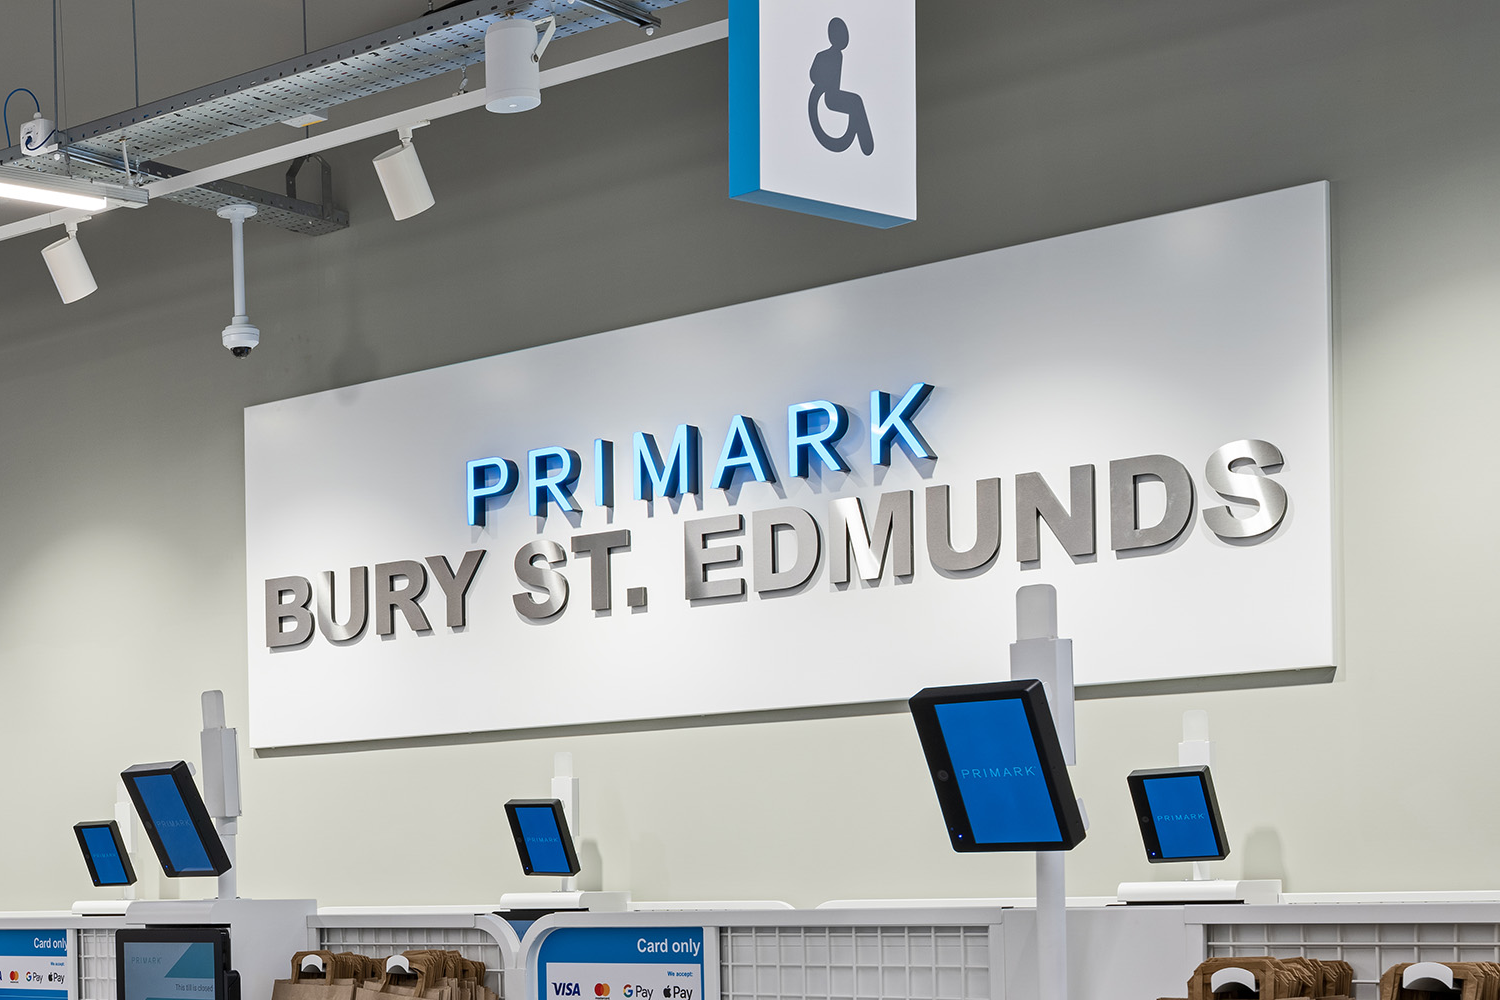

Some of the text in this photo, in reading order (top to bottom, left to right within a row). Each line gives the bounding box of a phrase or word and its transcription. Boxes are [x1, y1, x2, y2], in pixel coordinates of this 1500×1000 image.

[466, 382, 937, 527] PRIMARK
[265, 439, 1289, 648] BURY ST. EDMUNDS
[961, 765, 1036, 779] PRIMARK
[33, 937, 67, 951] Card only
[637, 938, 701, 957] Card only
[32, 972, 43, 984] Pay
[53, 972, 65, 984] Pay
[193, 984, 197, 992] is
[198, 984, 214, 992] closed
[551, 982, 581, 996] VISA
[635, 985, 654, 1000] Pay
[673, 985, 693, 1000] Pay
